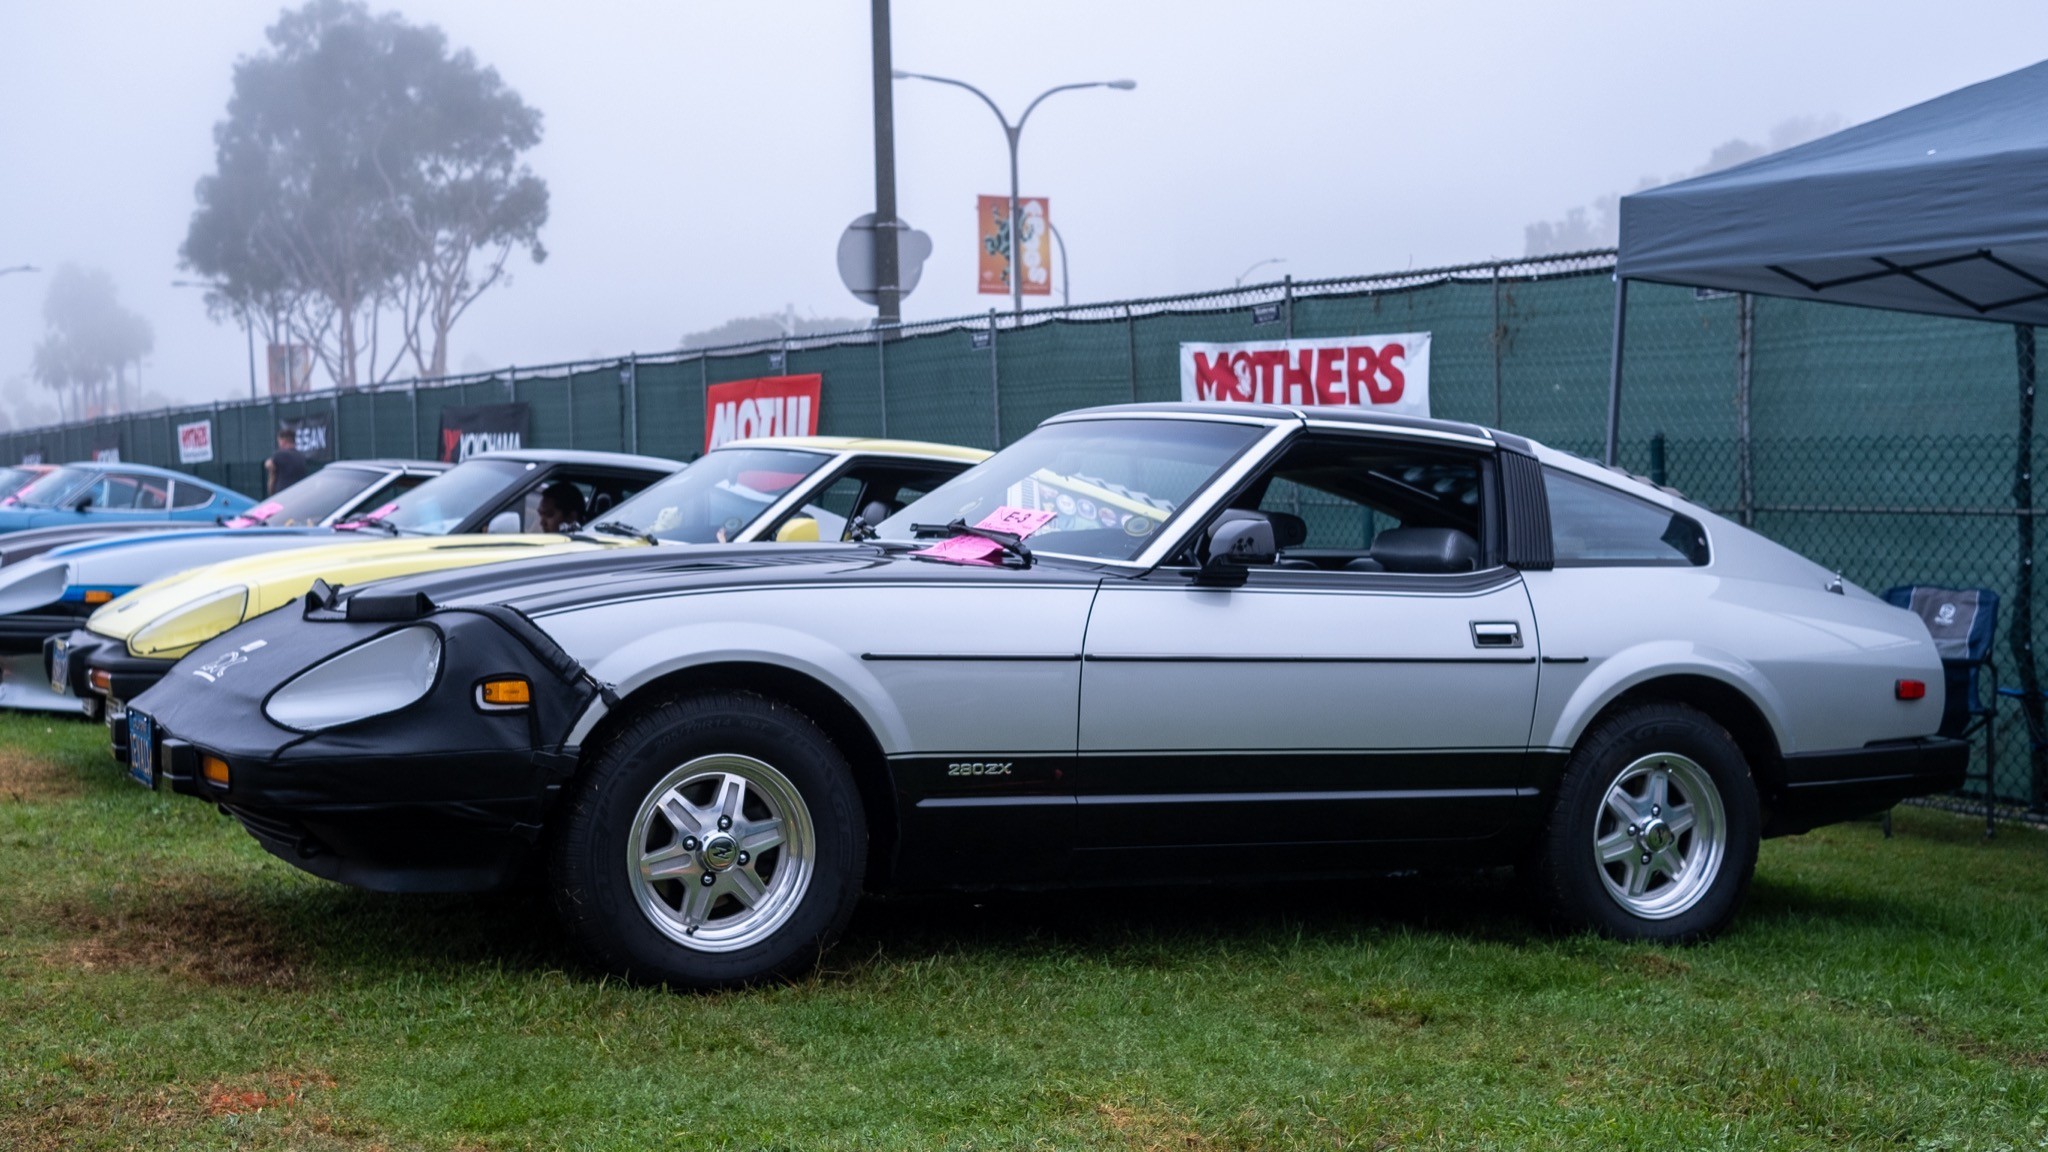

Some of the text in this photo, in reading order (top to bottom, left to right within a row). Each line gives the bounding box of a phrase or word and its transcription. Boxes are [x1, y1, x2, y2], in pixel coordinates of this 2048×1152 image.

[1193, 343, 1406, 405] MOTHERS
[294, 427, 327, 451] SSAN
[948, 763, 1013, 776] 280ZX
